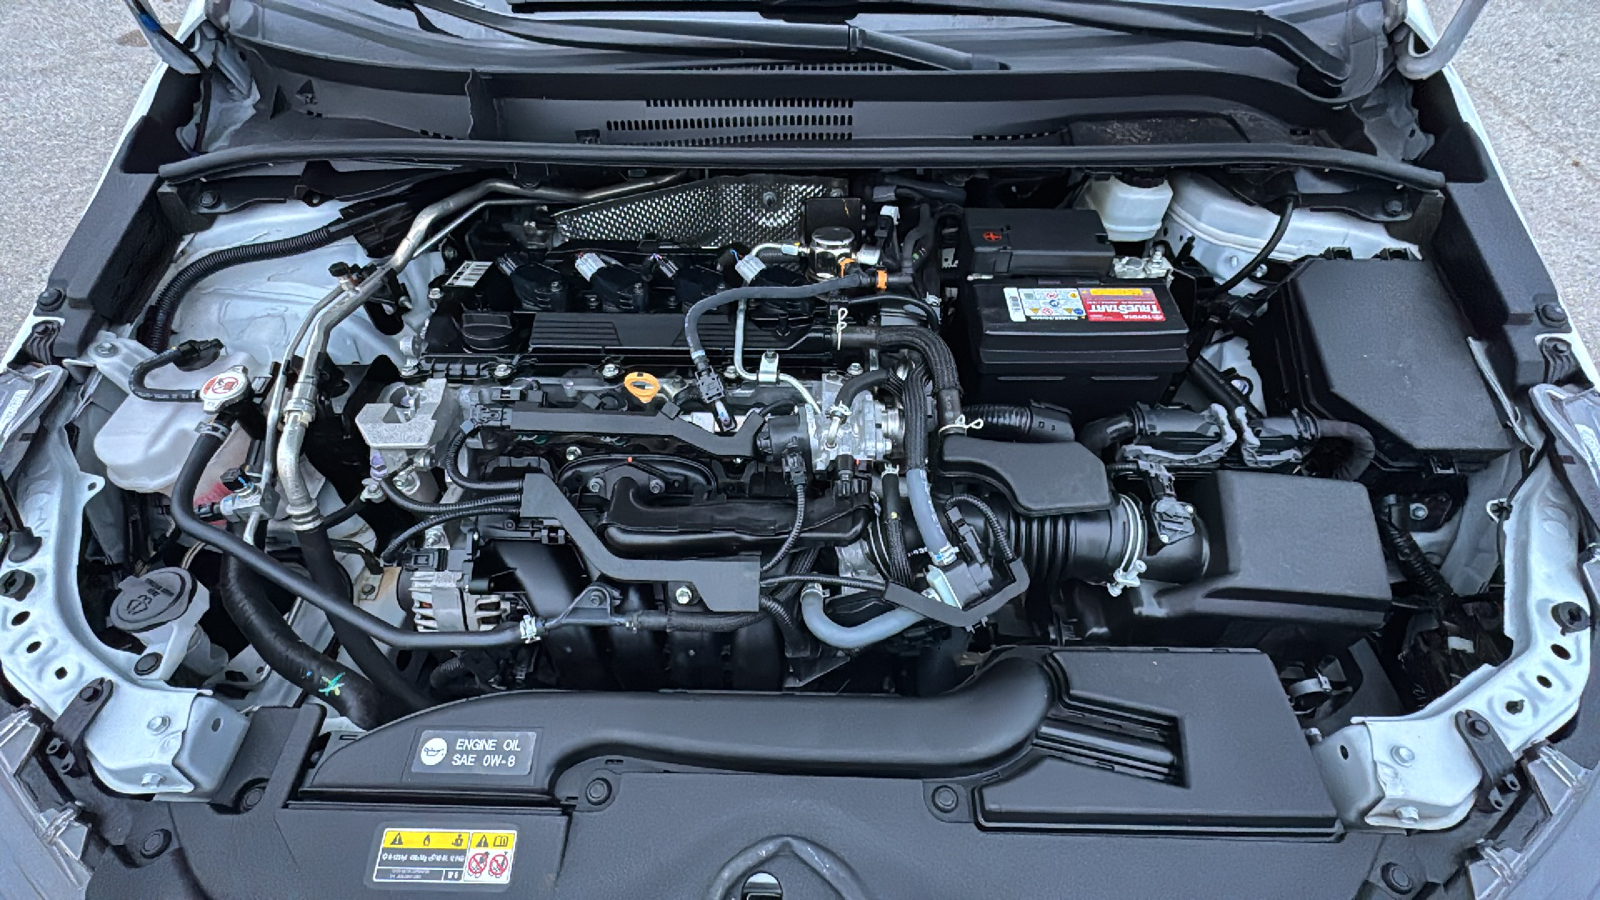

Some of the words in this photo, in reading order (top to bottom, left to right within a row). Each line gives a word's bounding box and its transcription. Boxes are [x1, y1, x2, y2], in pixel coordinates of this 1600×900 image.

[455, 738, 497, 751] ENGINE
[502, 739, 521, 751] OIL
[451, 754, 477, 766] SAE
[482, 755, 516, 767] 0W-8
